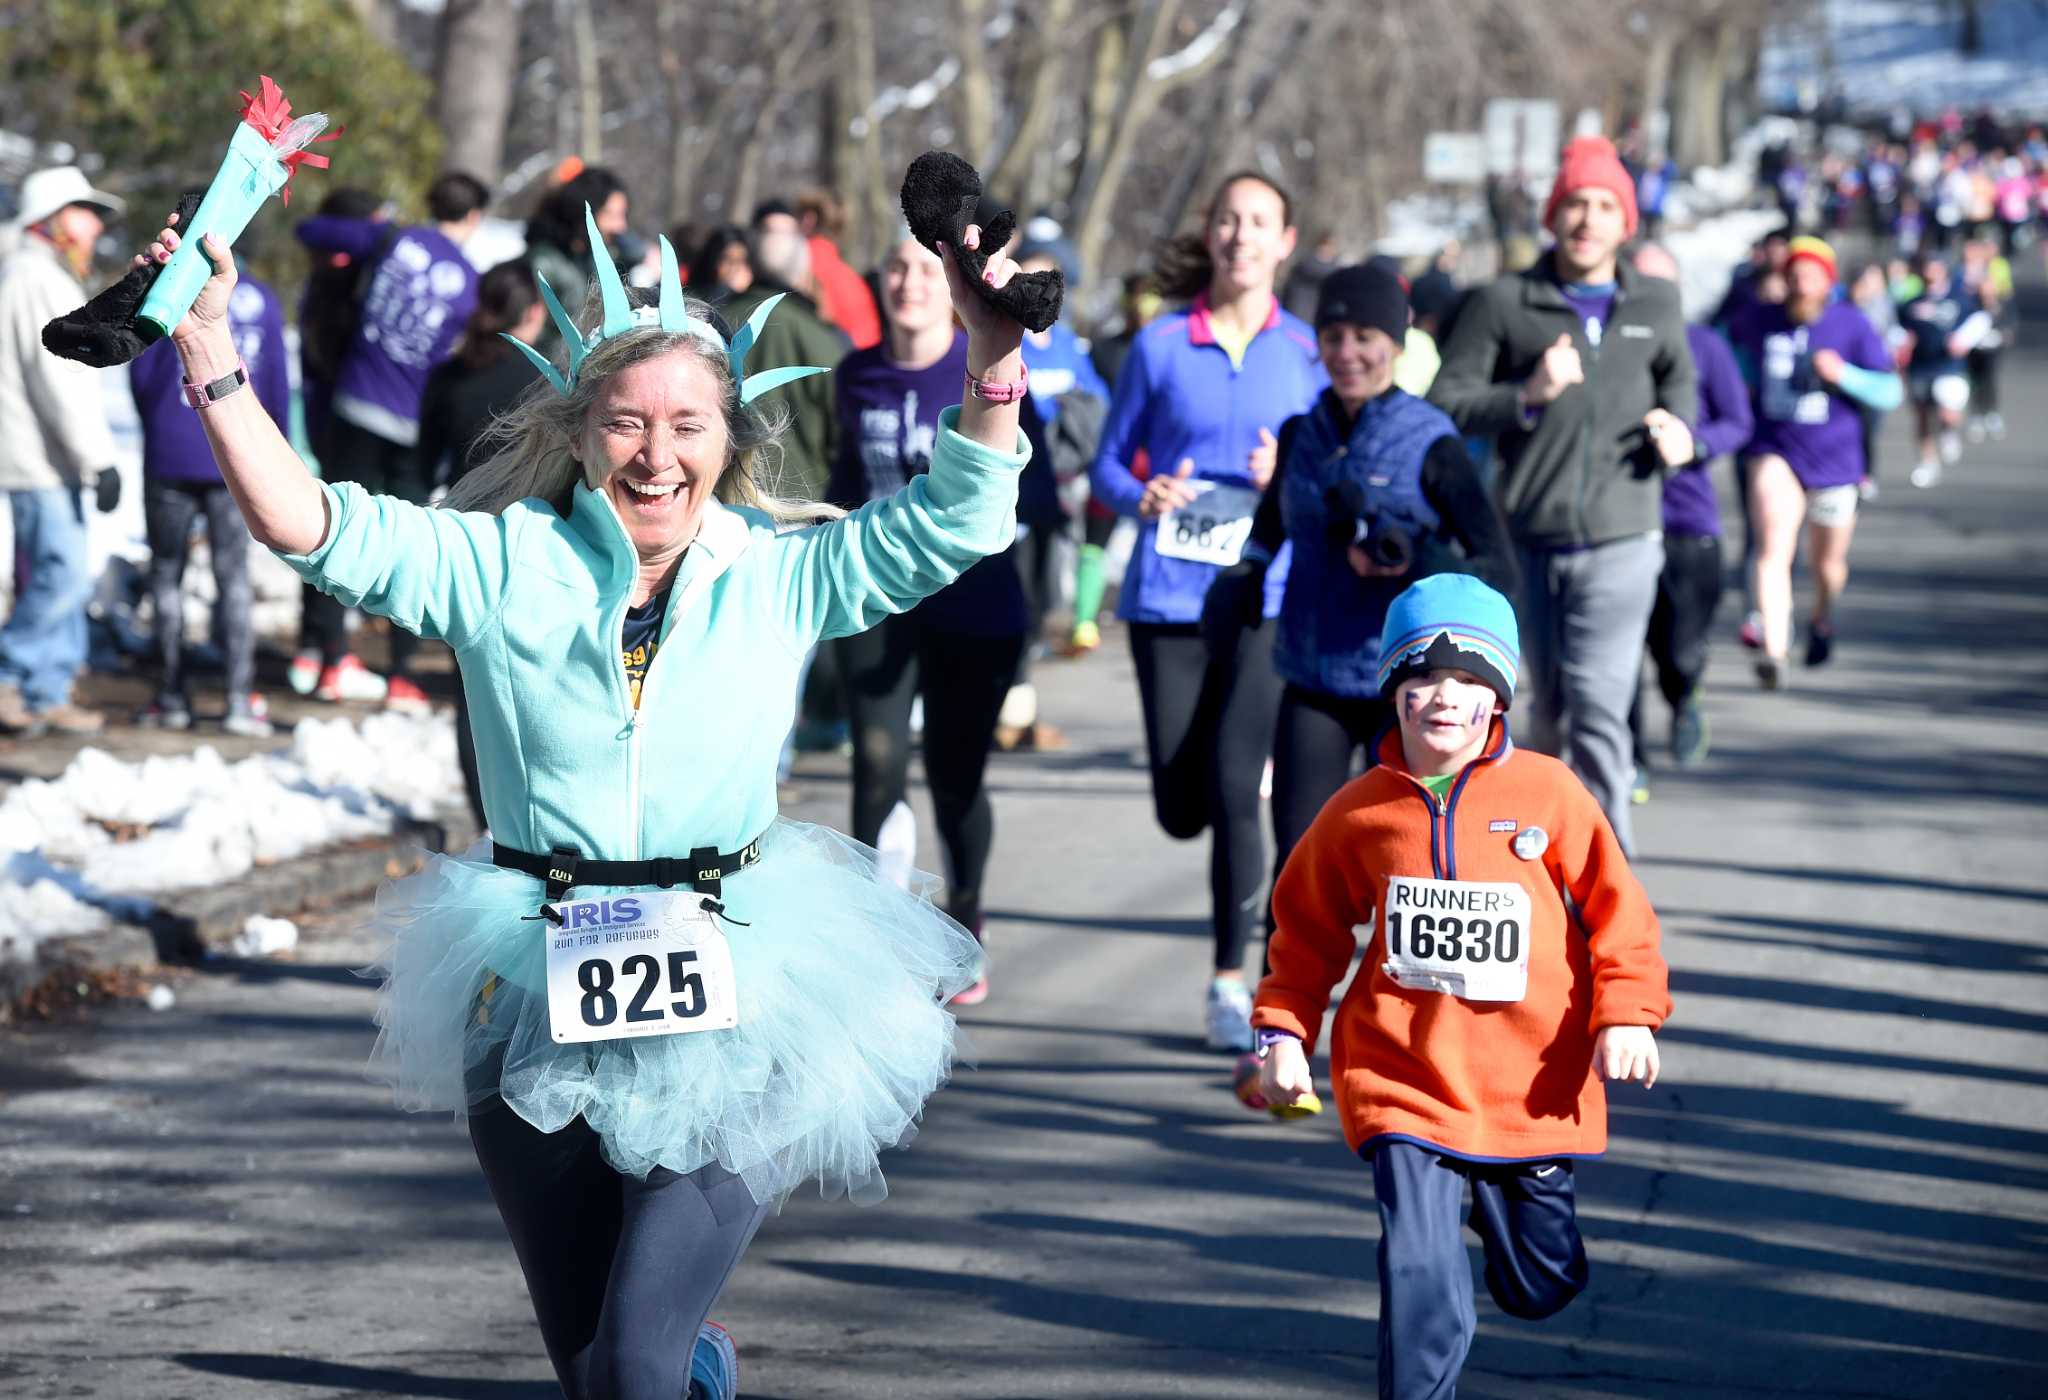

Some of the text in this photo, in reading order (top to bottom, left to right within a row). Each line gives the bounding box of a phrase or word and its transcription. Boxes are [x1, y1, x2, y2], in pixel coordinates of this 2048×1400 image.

[698, 868, 721, 880] run
[1396, 884, 1515, 912] RUNNERS
[560, 898, 641, 929] IRIS
[554, 937, 574, 949] RUN
[579, 934, 599, 946] FOR
[1388, 912, 1520, 963] 16330
[577, 950, 707, 1027] 825
